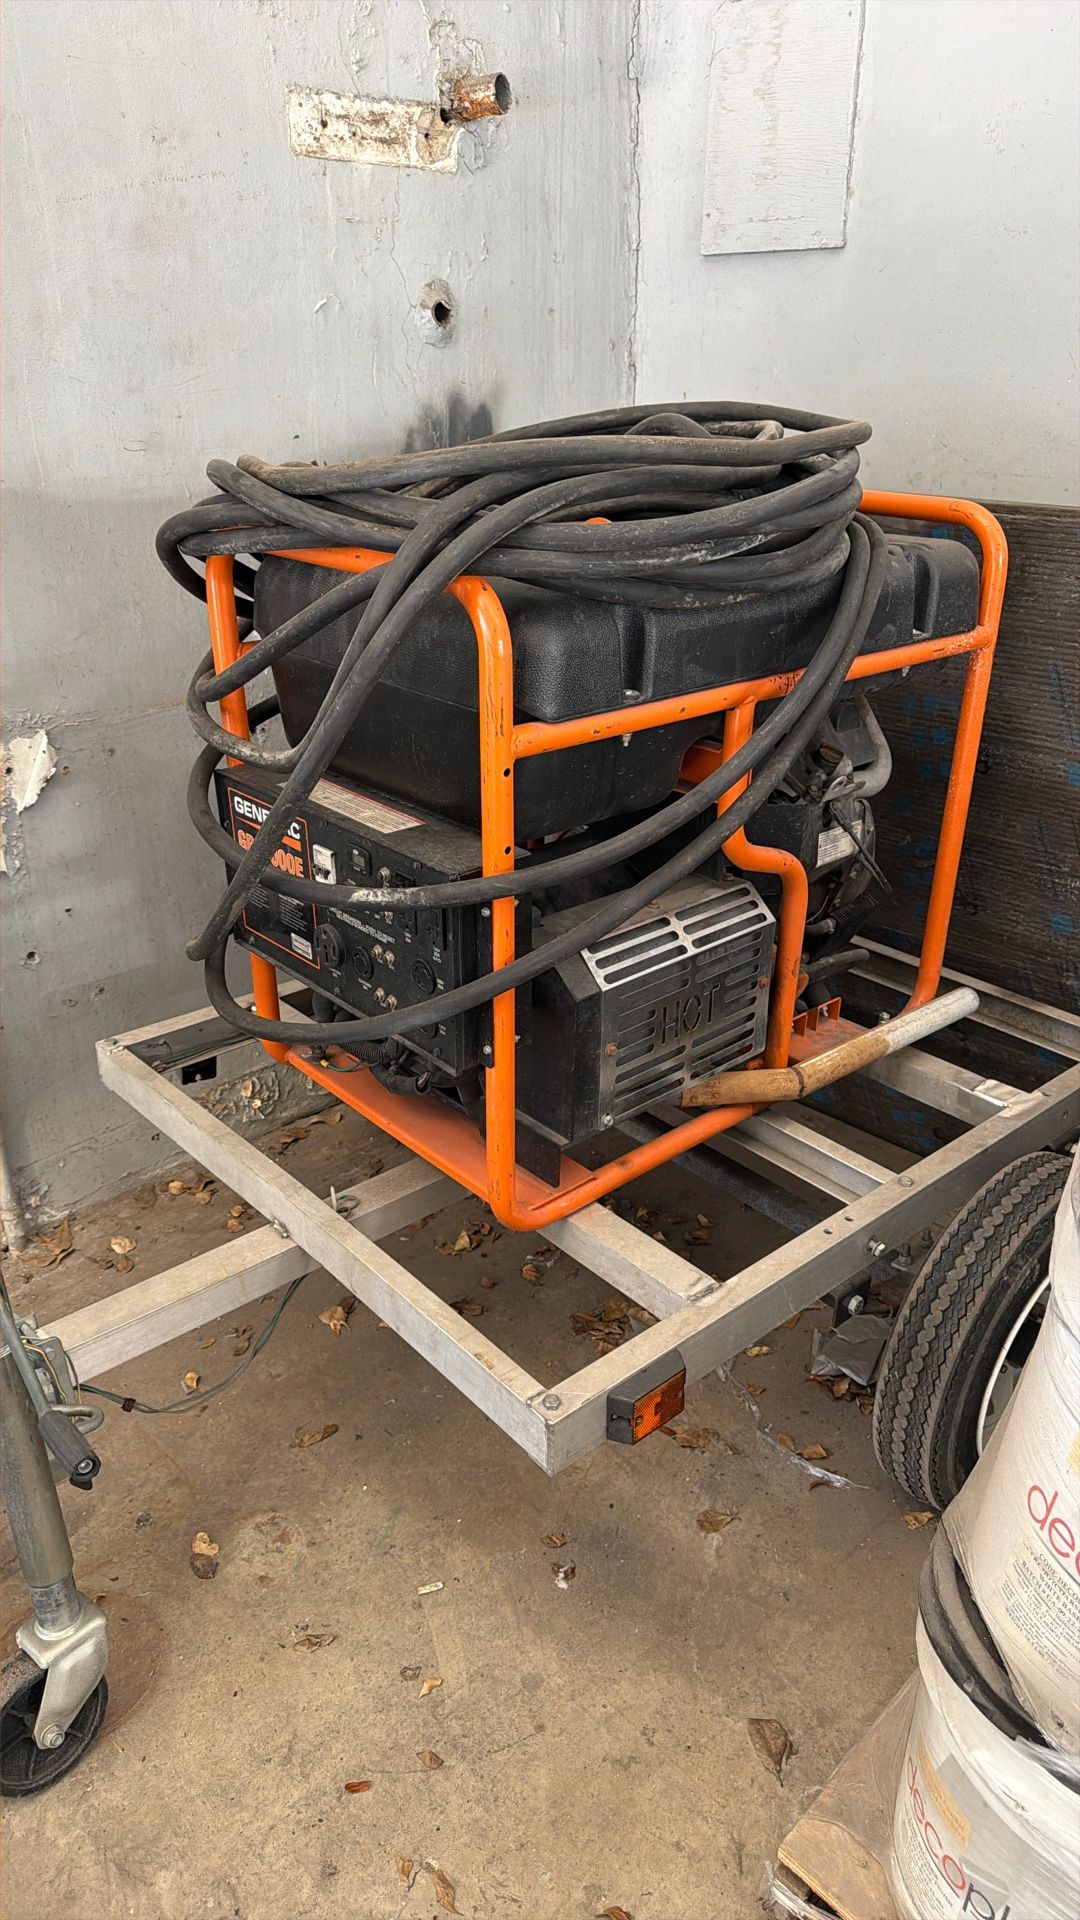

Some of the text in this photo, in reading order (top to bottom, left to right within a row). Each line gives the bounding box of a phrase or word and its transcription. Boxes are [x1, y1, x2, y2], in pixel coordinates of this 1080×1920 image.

[233, 796, 301, 840] GENEC
[660, 983, 721, 1045] HOT
[1027, 1485, 1080, 1577] de
